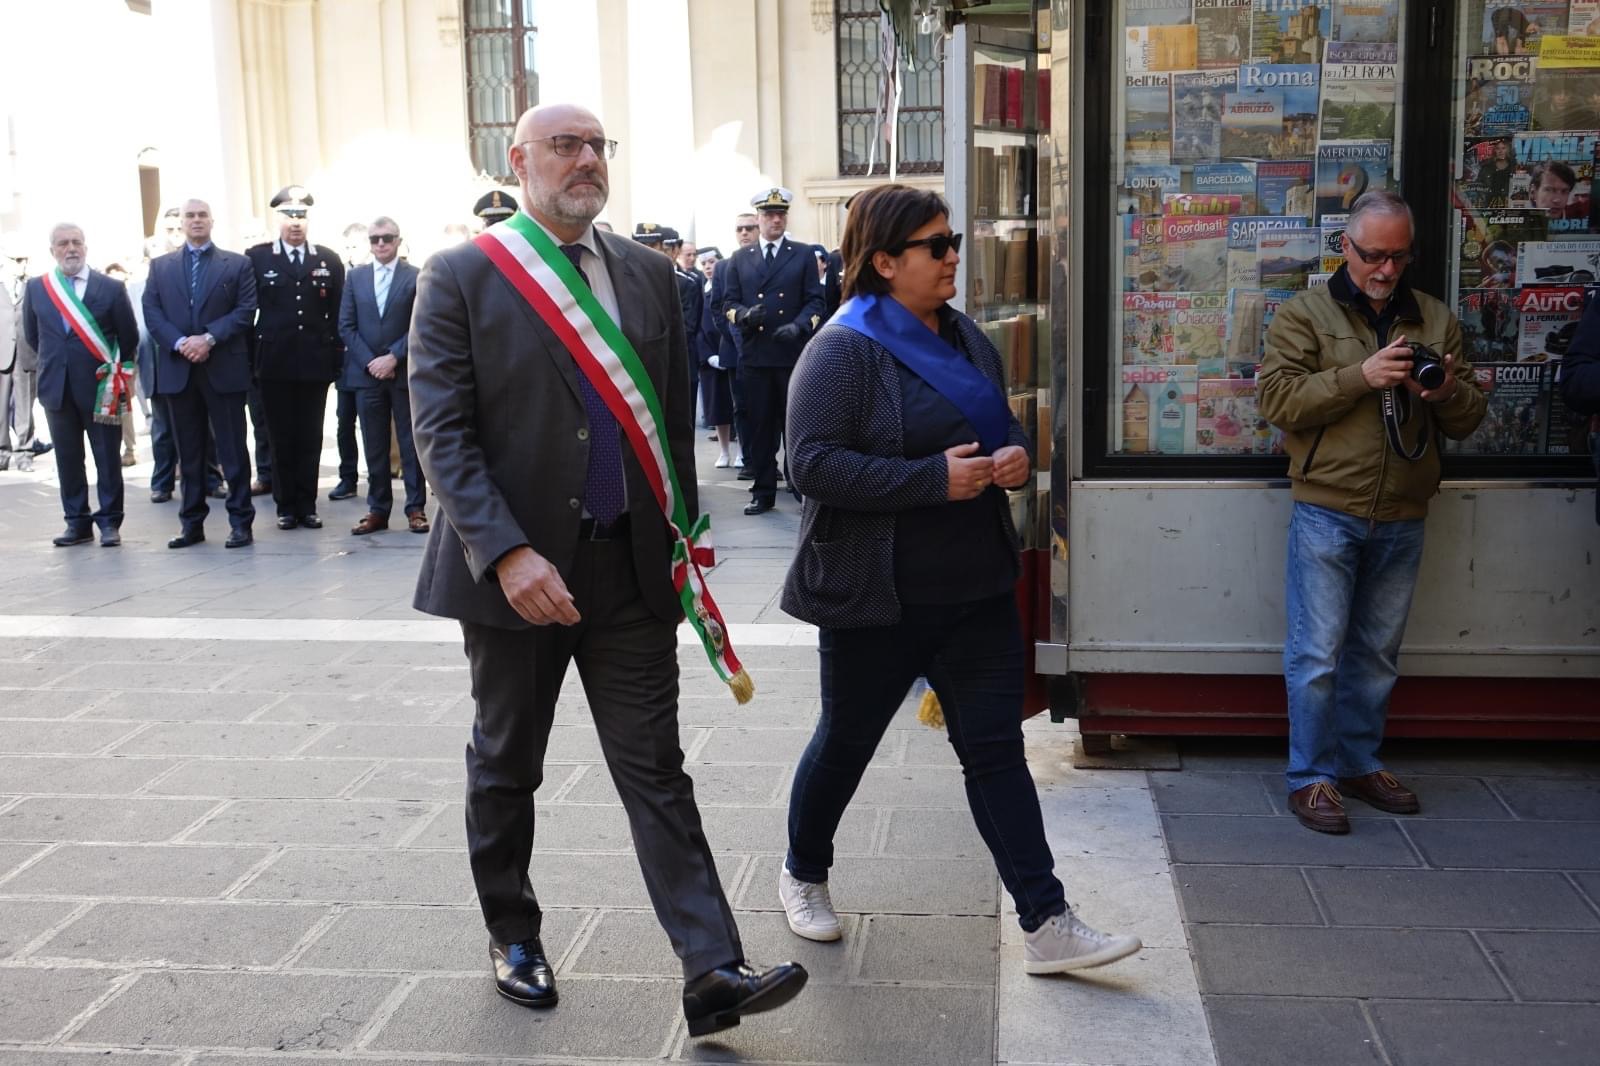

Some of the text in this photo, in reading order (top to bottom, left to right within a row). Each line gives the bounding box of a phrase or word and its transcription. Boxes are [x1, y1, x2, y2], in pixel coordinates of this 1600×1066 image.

[1246, 66, 1314, 87] Roma
[1496, 85, 1519, 106] 50
[1230, 104, 1274, 114] ABRUZZO
[1320, 146, 1387, 158] MERIDIANI
[1124, 177, 1175, 189] LONDRA
[1196, 175, 1253, 185] BARCELLONA
[1168, 219, 1223, 238] Coordinati
[1495, 366, 1541, 383] ECCOLI!
